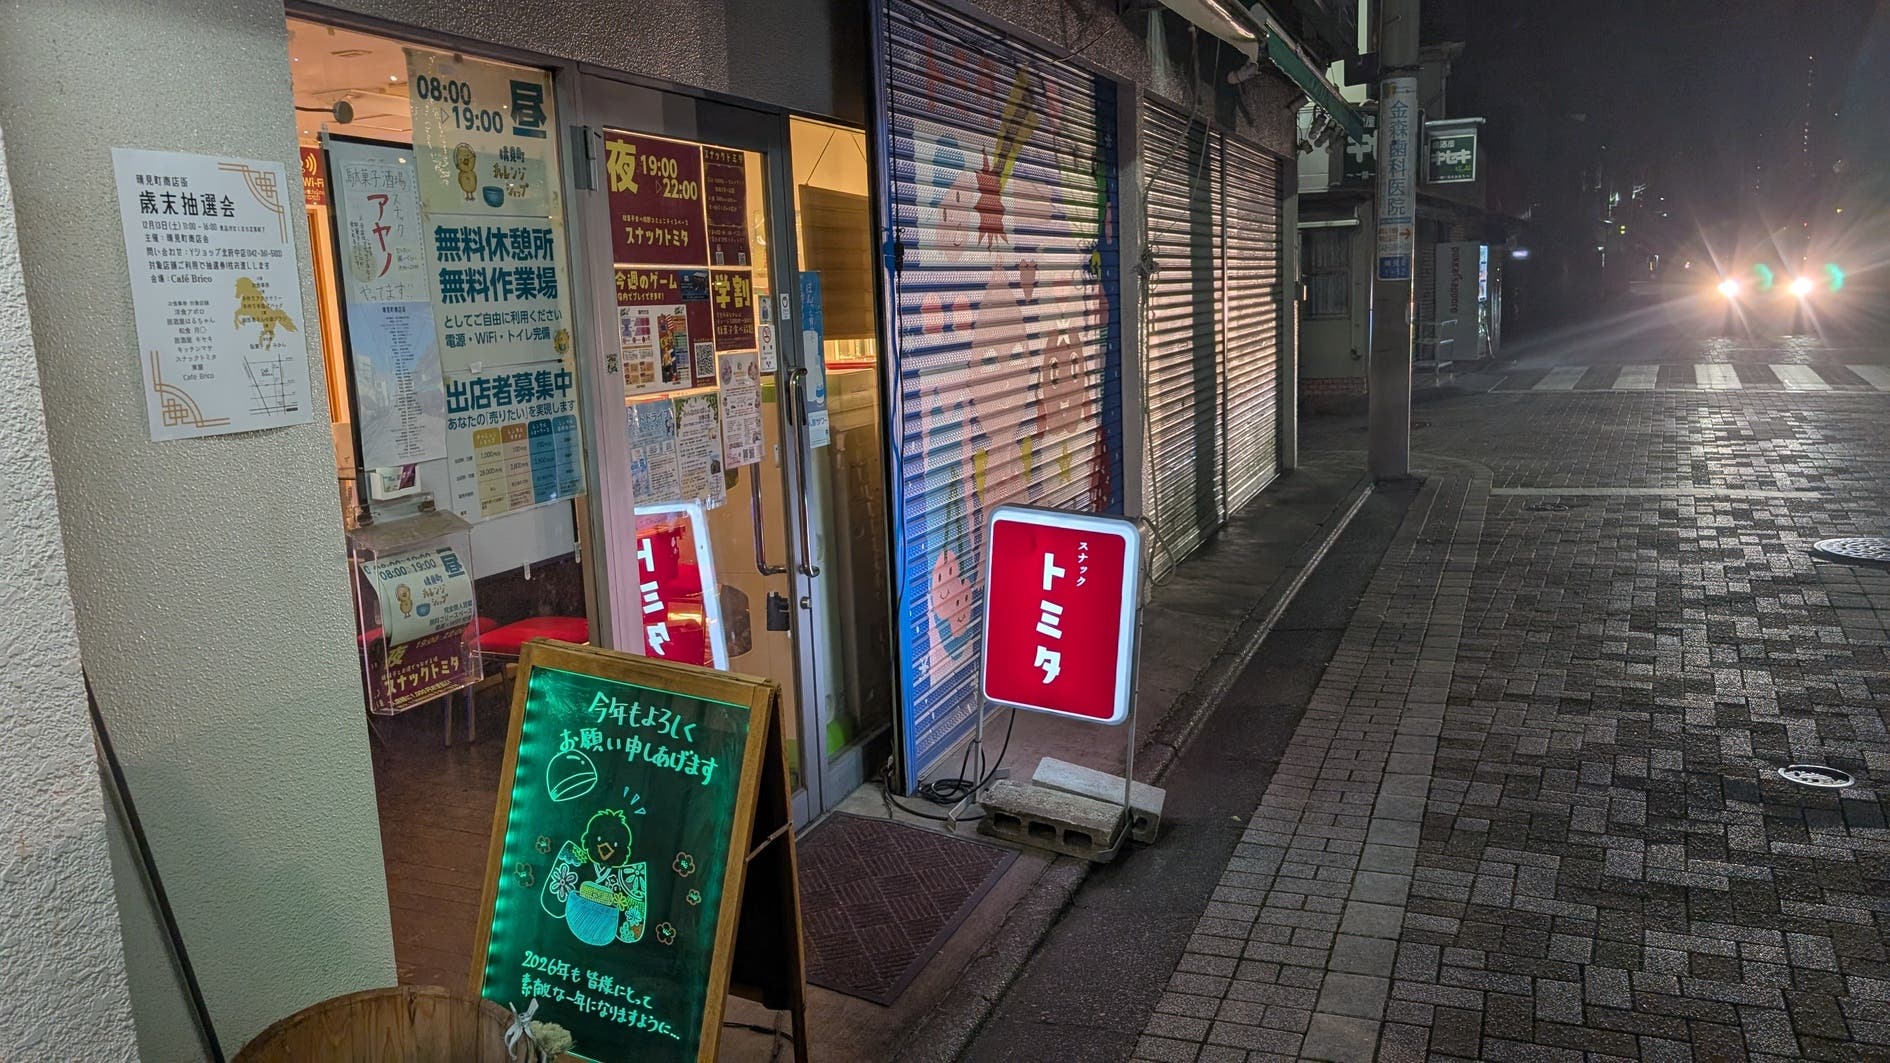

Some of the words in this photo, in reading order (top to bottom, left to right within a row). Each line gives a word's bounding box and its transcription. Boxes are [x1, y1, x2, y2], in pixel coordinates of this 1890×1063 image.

[417, 75, 471, 106] 08:00
[452, 105, 504, 134] 19:00
[510, 80, 547, 139] 昼
[499, 145, 525, 163] 晴見町
[605, 139, 639, 194] 夜
[640, 154, 678, 178] 19:00
[704, 149, 744, 163] スナックトミタ
[1388, 100, 1409, 216] 金森歯科医院
[135, 174, 189, 187] 晴見町商店街
[662, 178, 698, 201] 22:00
[139, 190, 236, 218] 歳末抽選会
[367, 193, 392, 279] アヤノ
[434, 225, 554, 263] 無料休憩所
[625, 226, 689, 247] スナックトミタ
[438, 266, 558, 304] 無料作業場
[615, 270, 678, 290] 今週のゲーム
[714, 273, 751, 309] 学割
[444, 309, 563, 329] としてご自由に利用ください
[445, 368, 573, 415] 出店者募集中
[447, 400, 576, 431] あなたの「売りたい」を実現します
[379, 565, 408, 581] 08:00
[412, 559, 437, 573] 19:00
[440, 552, 466, 579] 昼
[1076, 541, 1089, 587] スナック
[1033, 552, 1066, 685] トミタ
[382, 656, 460, 697] スナックトミタ
[588, 691, 697, 742] 今年もよろしく
[559, 728, 718, 786] お願い申しあげます
[521, 950, 581, 983] 2026年も
[587, 969, 653, 1010] 皆様にとって
